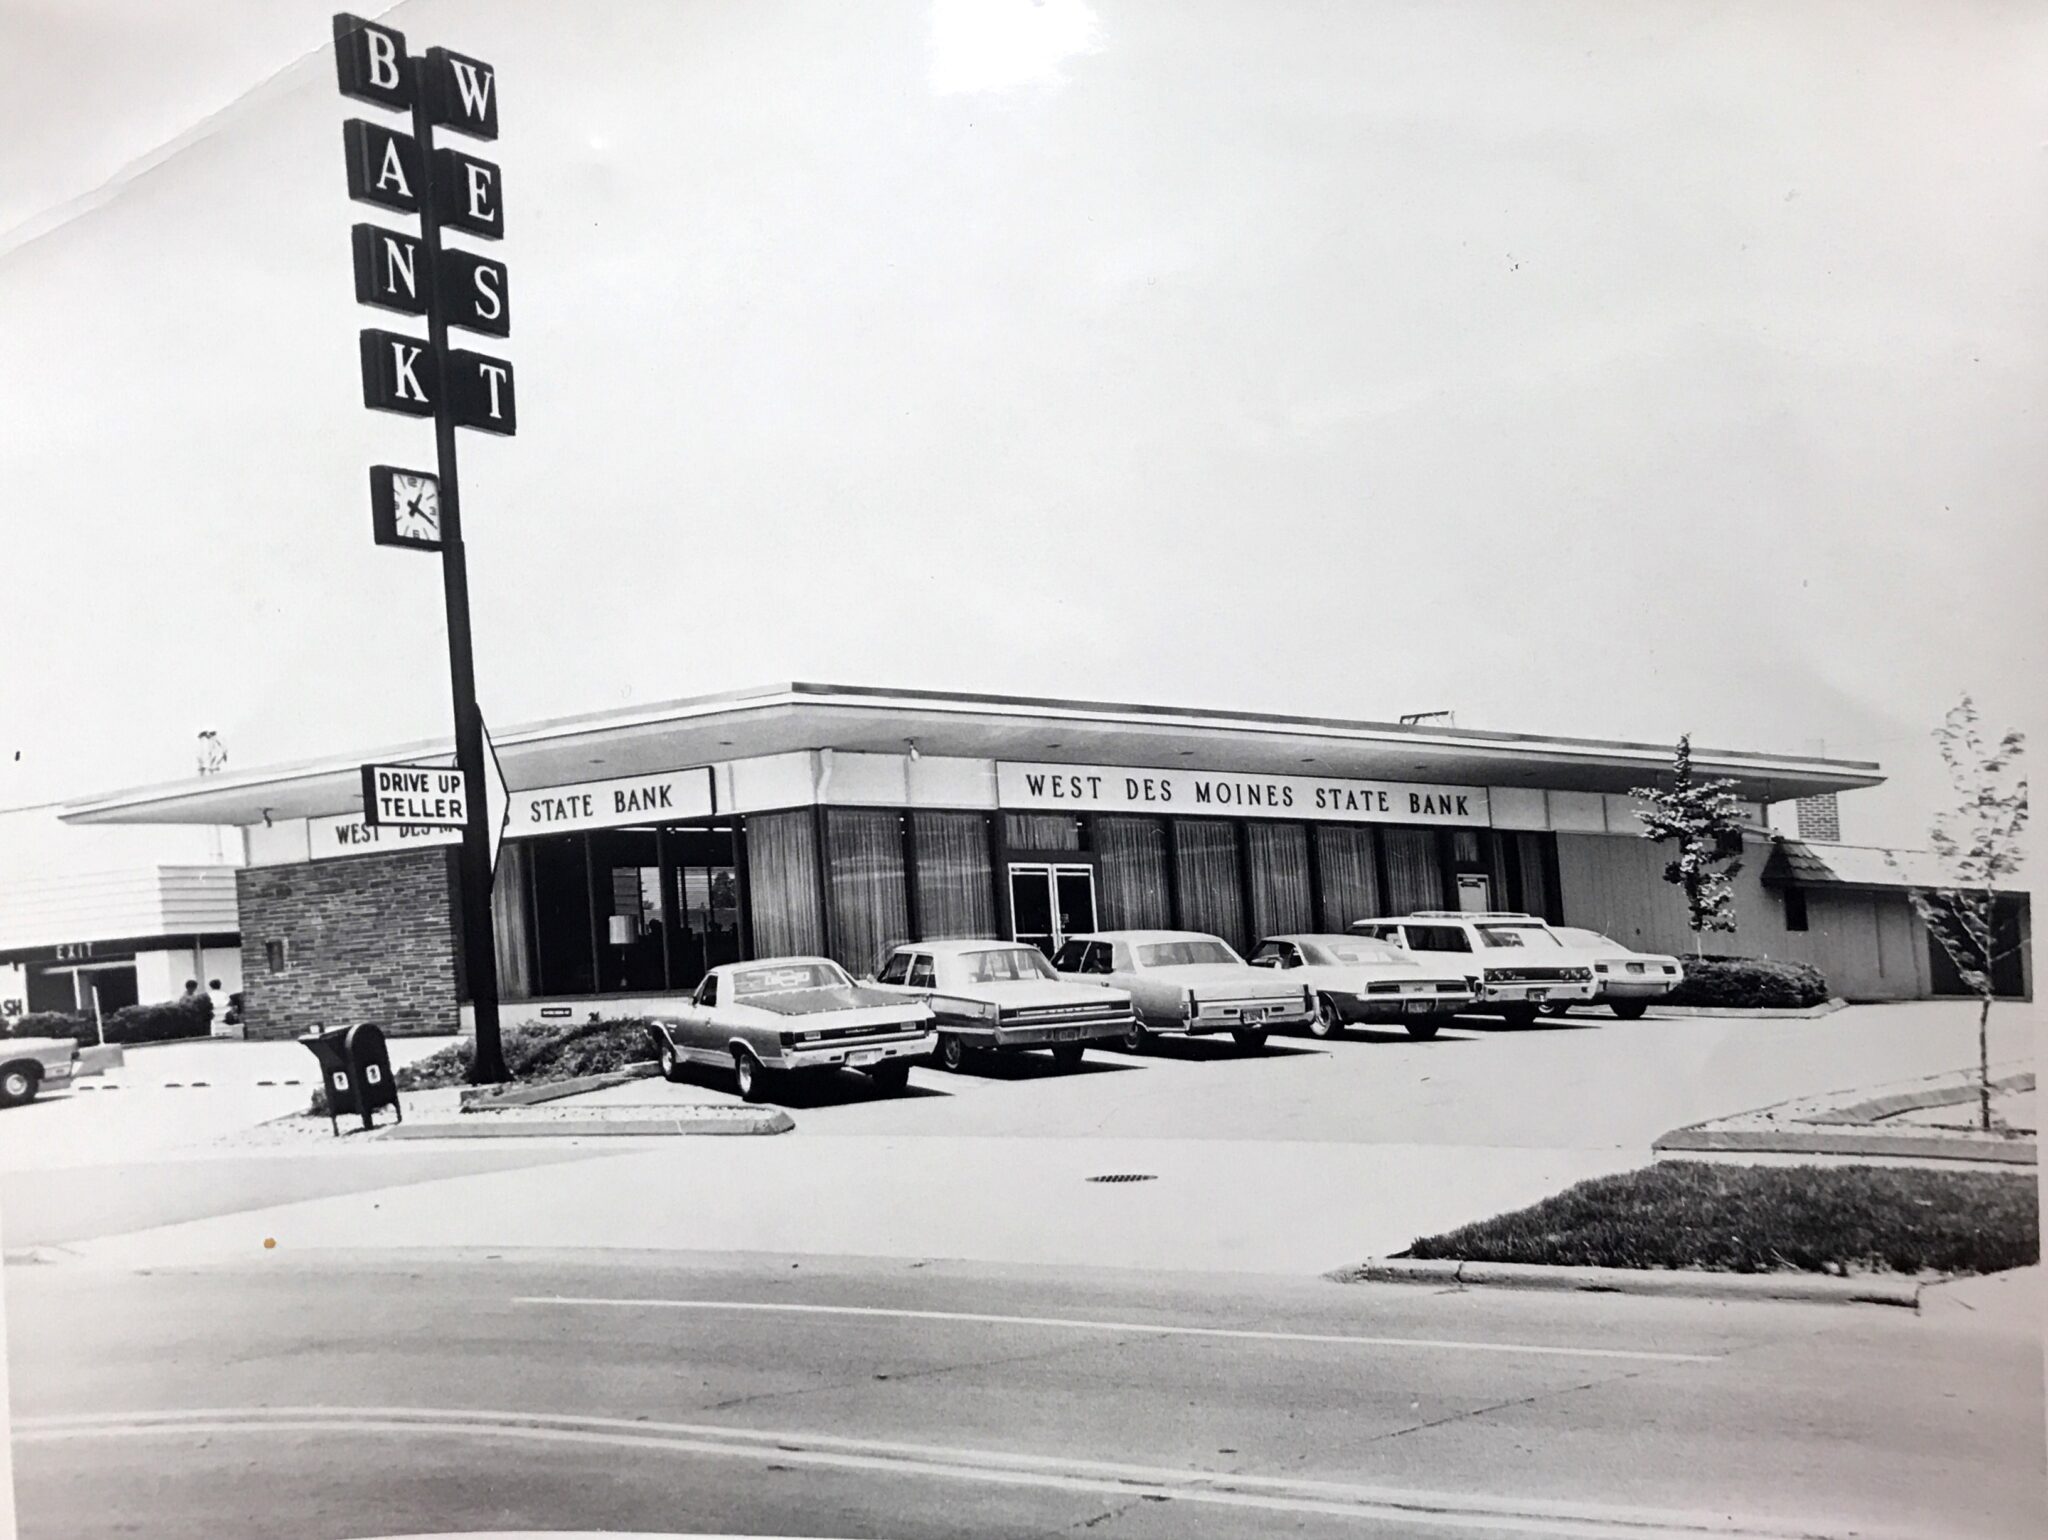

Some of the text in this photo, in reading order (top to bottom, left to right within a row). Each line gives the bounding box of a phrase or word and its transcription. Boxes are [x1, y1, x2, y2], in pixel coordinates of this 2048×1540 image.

[363, 28, 430, 403] BANK
[449, 57, 507, 420] WEST
[379, 772, 461, 794] DRIVE UP
[530, 784, 673, 823] STATE BANK
[1025, 774, 1470, 816] WEST DES MOINES STATE BANK
[380, 797, 463, 818] TELLER
[335, 823, 379, 845] WEST
[56, 942, 93, 960] EXIT
[0, 999, 22, 1017] SH
